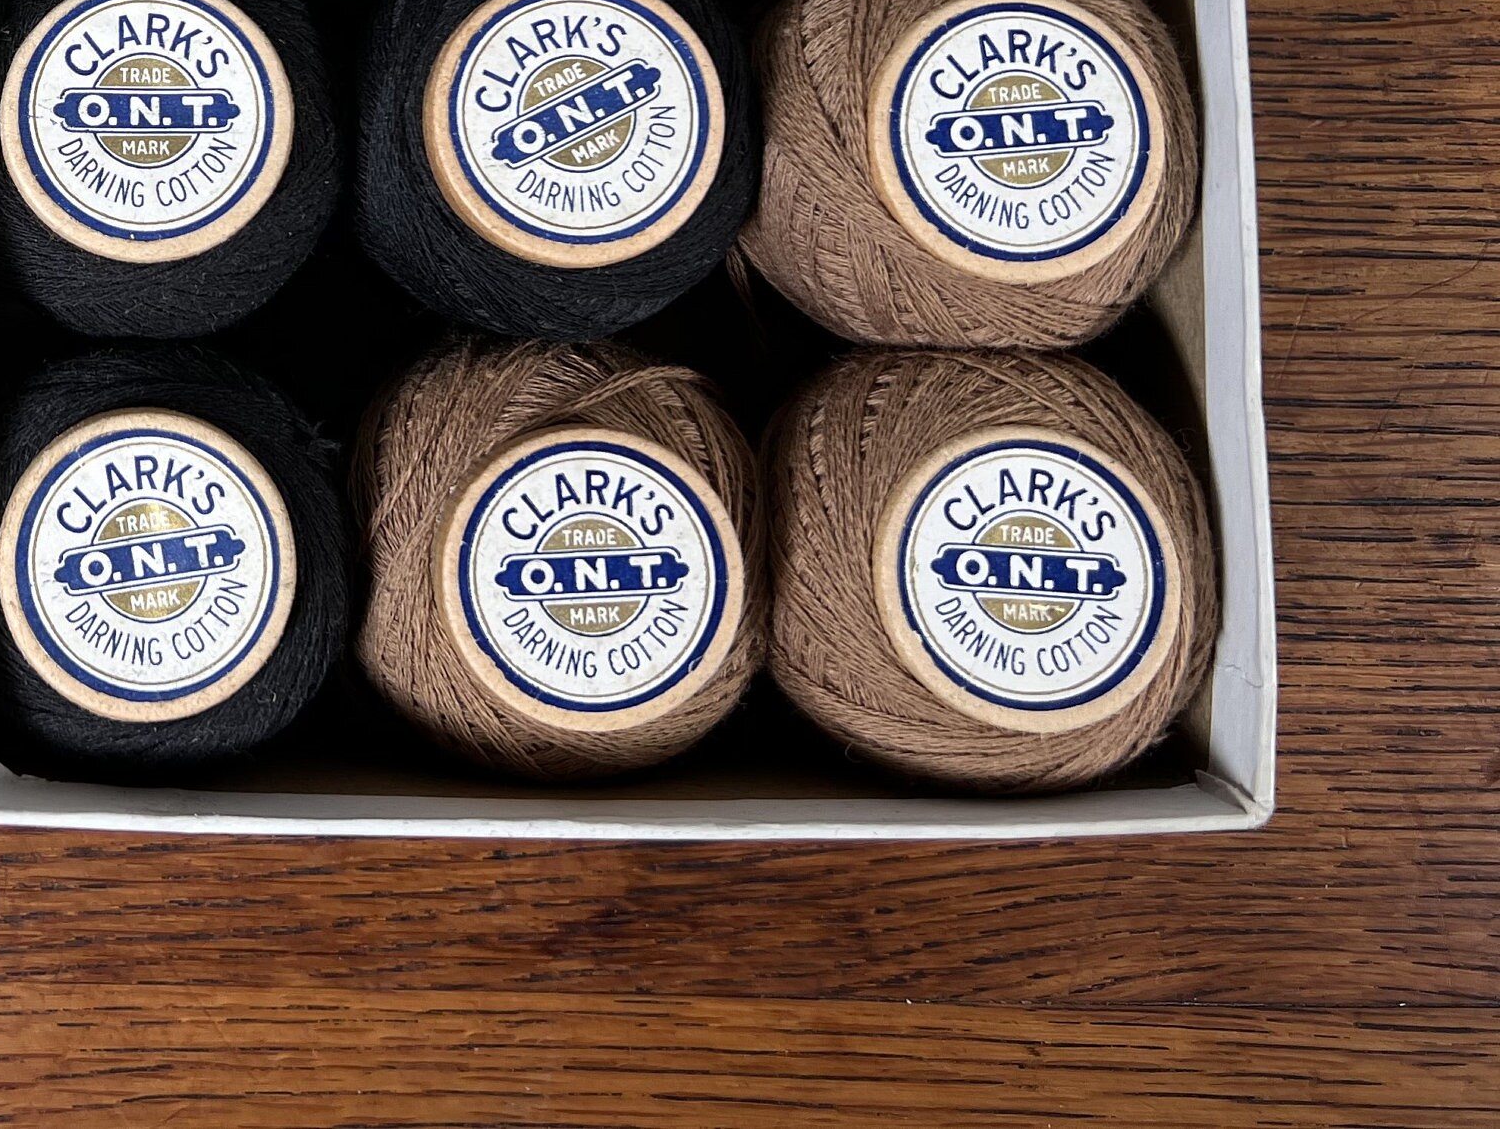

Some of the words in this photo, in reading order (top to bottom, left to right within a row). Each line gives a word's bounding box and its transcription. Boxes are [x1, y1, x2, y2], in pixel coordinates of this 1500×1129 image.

[63, 11, 231, 79] CLARK'S
[474, 13, 628, 113] CLARK'S
[928, 28, 1098, 100] CLARK'S
[119, 67, 173, 85] TRADE
[532, 63, 587, 99] TRADE
[987, 83, 1043, 104] TRADE
[56, 137, 145, 208] DARNING
[154, 136, 238, 208] COTTON
[121, 140, 171, 158] MARK
[515, 169, 621, 213] DARNING
[621, 104, 678, 194] COTTON
[570, 130, 620, 167] MARK
[999, 158, 1050, 180] MARK
[934, 163, 1030, 230] DARNING
[1038, 149, 1116, 226] COTTON
[55, 454, 226, 534] CLARK'S
[501, 468, 675, 541] CLARK'S
[942, 466, 1117, 542] CLARK'S
[115, 510, 172, 535] TRADE
[561, 527, 618, 547] TRADE
[1000, 523, 1057, 546] TRADE
[64, 600, 164, 667] DARNING
[171, 576, 249, 661] COTTON
[129, 588, 182, 615] MARK
[569, 605, 621, 626] MARK
[1001, 602, 1053, 623] MARK
[502, 607, 598, 679] DARNING
[607, 598, 689, 677] COTTON
[934, 596, 1026, 676] DARNING
[1036, 604, 1124, 677] COTTON
